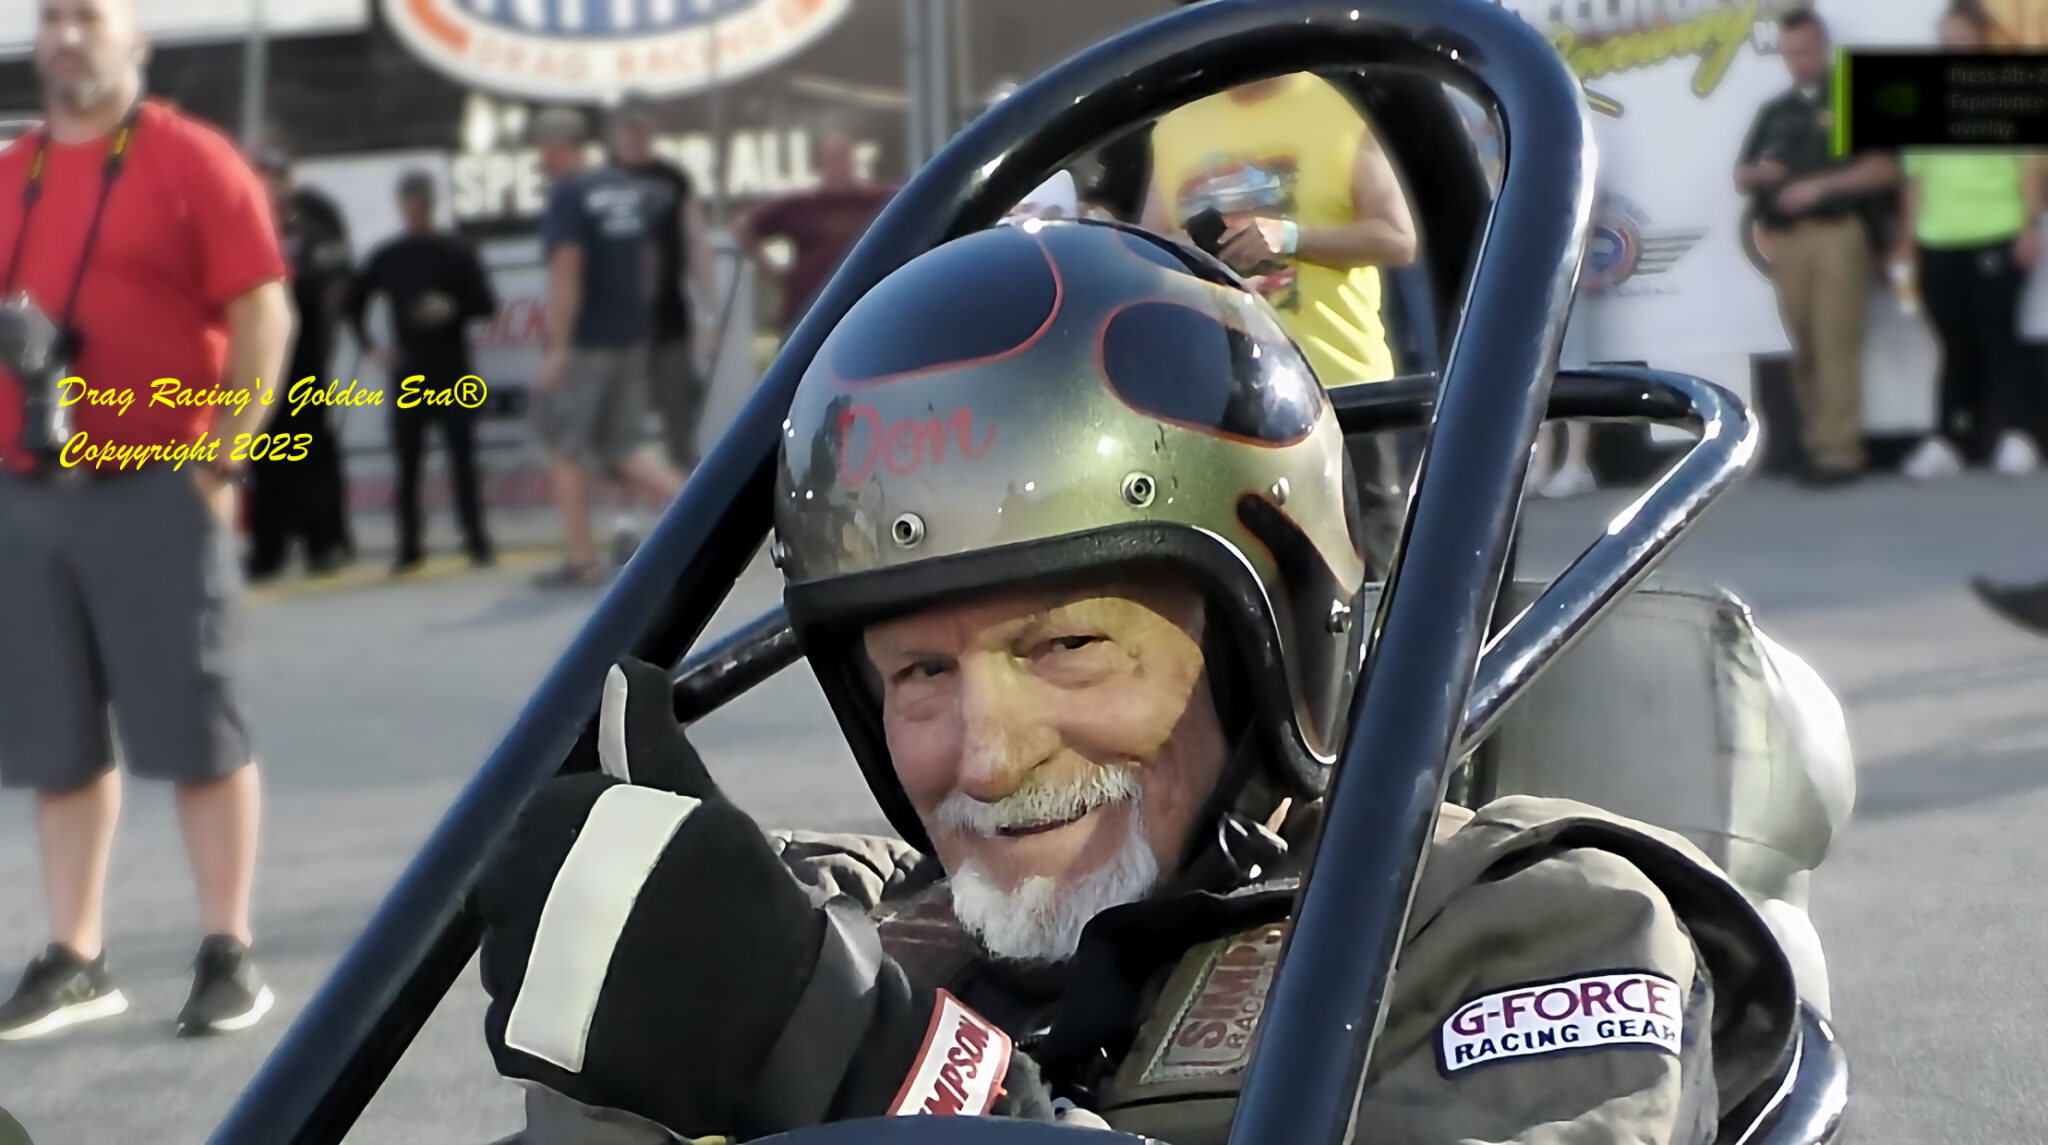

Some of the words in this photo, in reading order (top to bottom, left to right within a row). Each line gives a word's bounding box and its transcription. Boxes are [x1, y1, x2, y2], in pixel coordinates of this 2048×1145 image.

[477, 34, 589, 81] DRAG
[836, 404, 998, 487] Don
[1451, 978, 1674, 1037] G-FORCE
[919, 1014, 990, 1116] MPSON
[1455, 1023, 1581, 1064] RACING
[1596, 1018, 1677, 1043] GEAR
